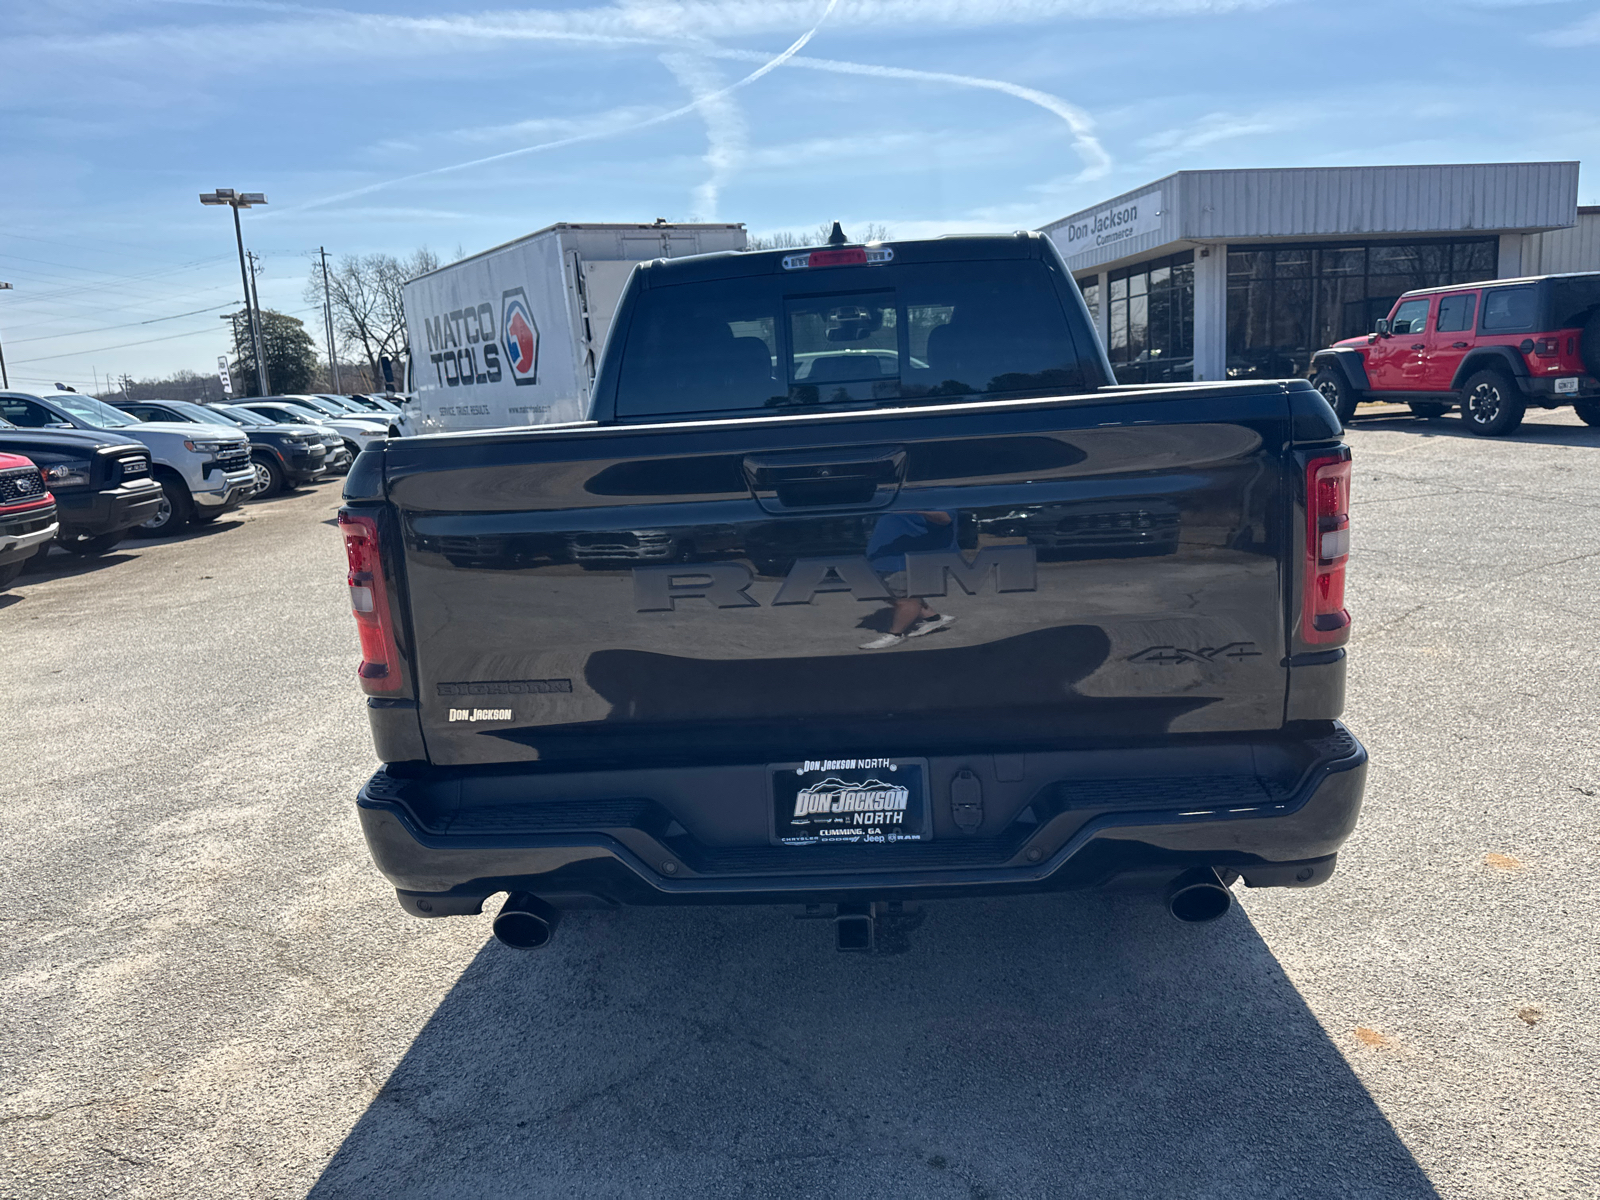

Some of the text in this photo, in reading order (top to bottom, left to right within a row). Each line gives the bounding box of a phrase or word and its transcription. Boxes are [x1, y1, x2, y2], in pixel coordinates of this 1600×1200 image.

[1068, 206, 1137, 243] Don Jackson
[1096, 226, 1134, 247] Commerce
[424, 302, 496, 351] MATCO
[430, 344, 502, 388] TOOLS
[632, 545, 1037, 613] RAM
[857, 758, 890, 769] NORTH
[793, 789, 909, 817] DON JACKSON
[853, 811, 903, 825] NORTH
[863, 834, 885, 843] Jeep
[867, 827, 882, 835] GA
